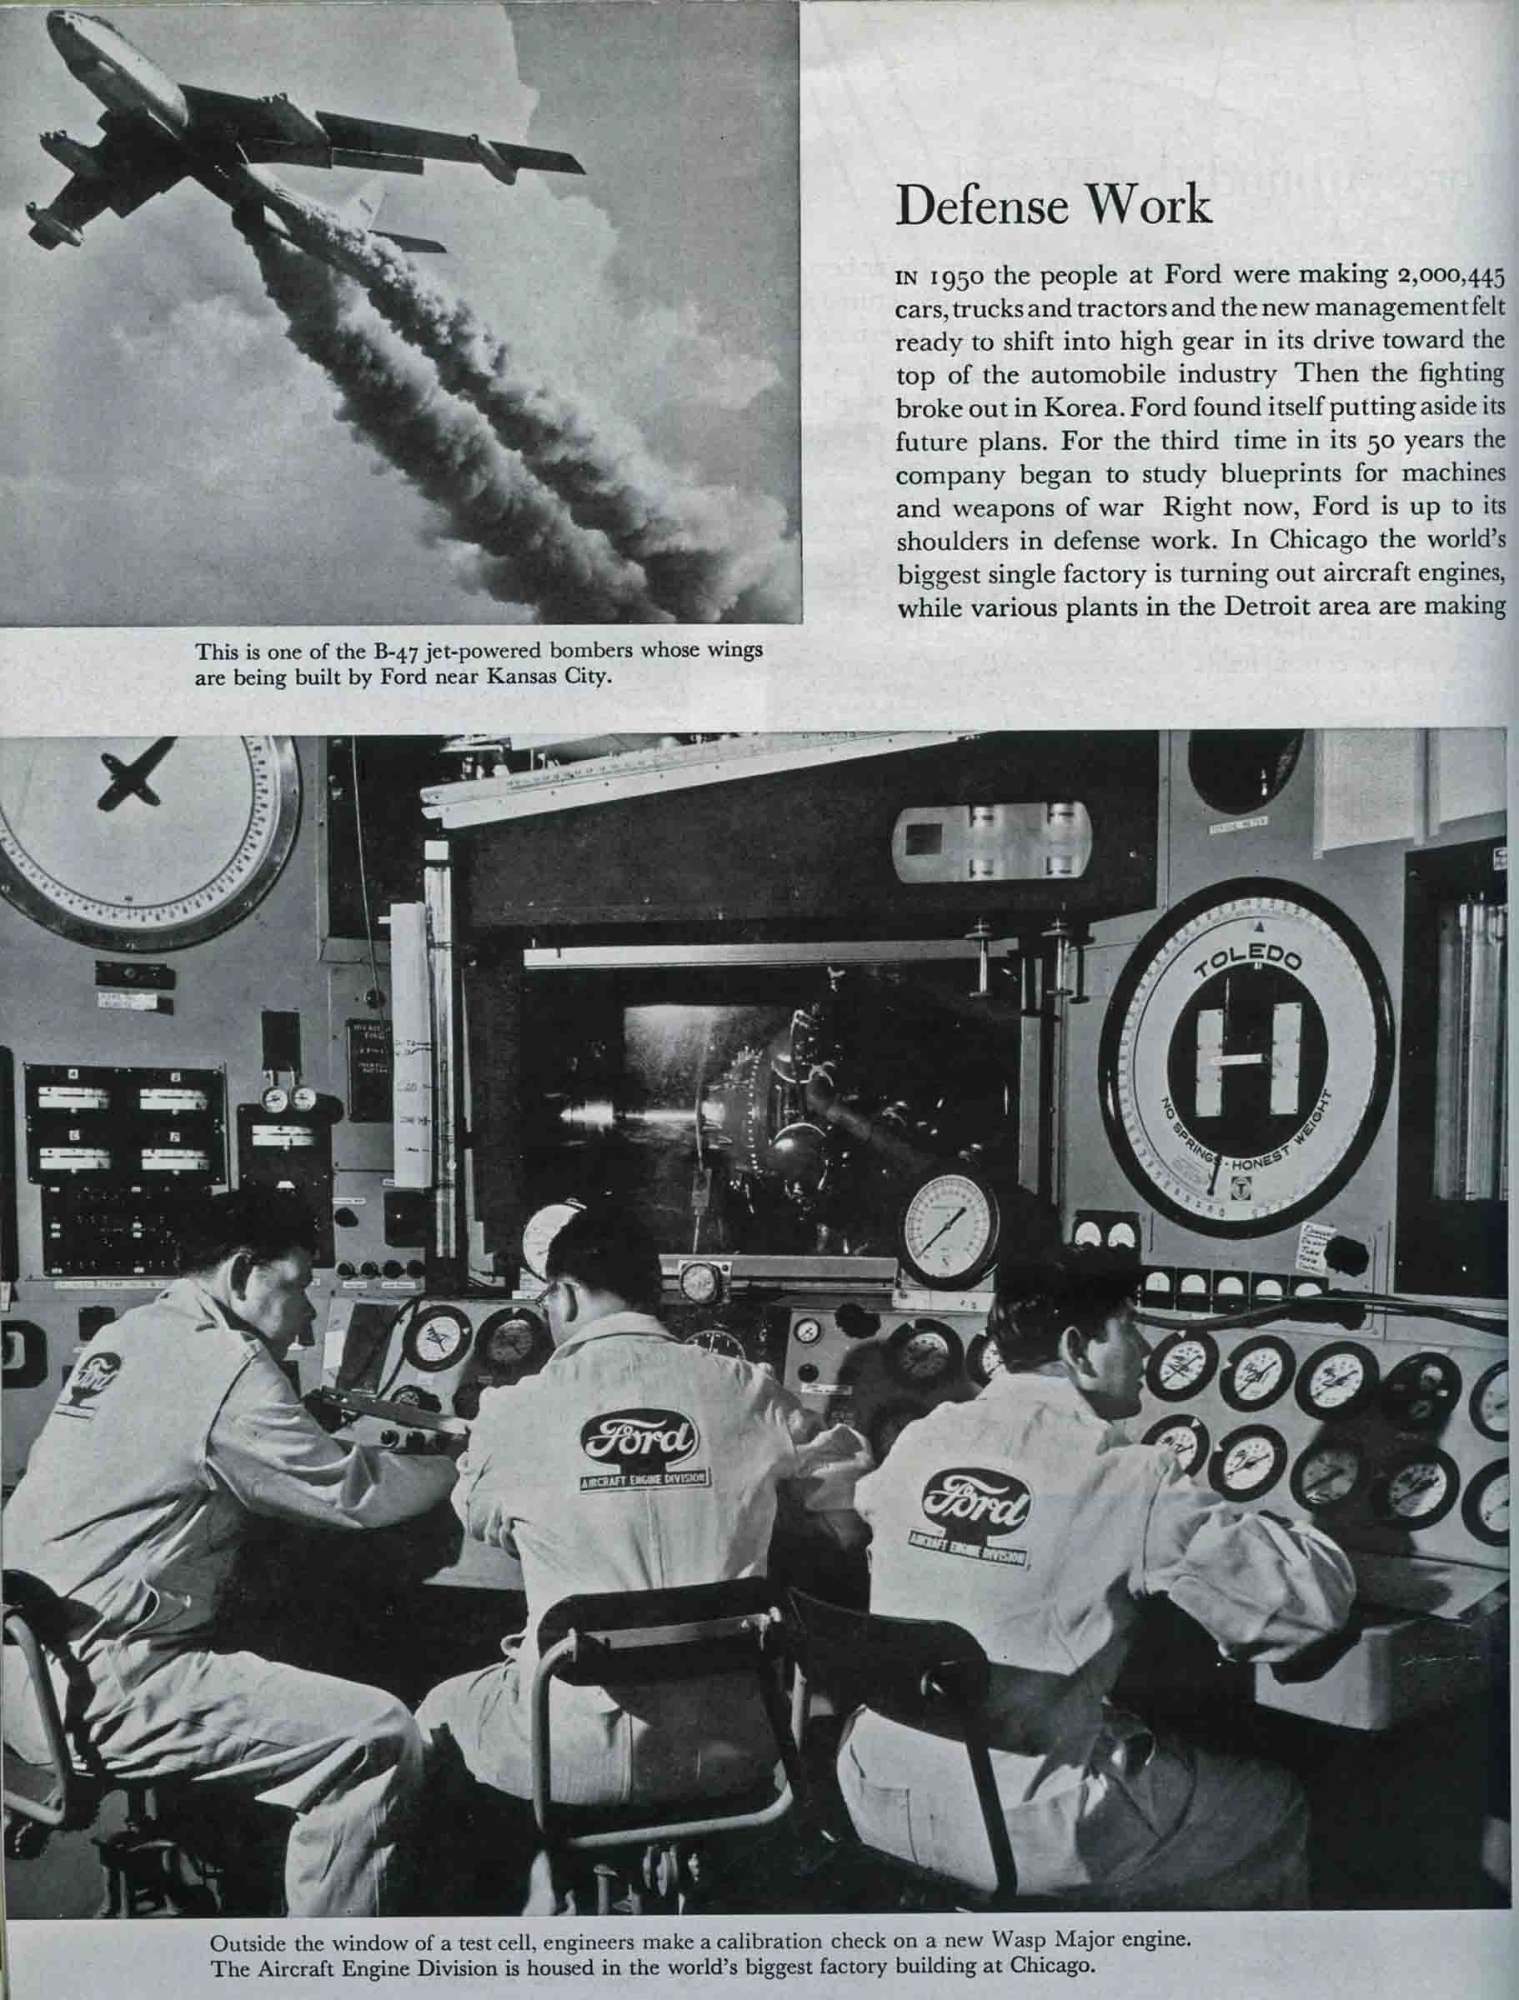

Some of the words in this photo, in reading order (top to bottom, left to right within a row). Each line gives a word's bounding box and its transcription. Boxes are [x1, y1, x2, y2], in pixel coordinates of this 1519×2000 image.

[895, 183, 1069, 225] Defense
[1083, 180, 1214, 225] Work
[893, 269, 919, 286] IN
[930, 269, 985, 293] 1950
[993, 263, 1032, 286] the
[1039, 263, 1119, 292] people
[1128, 266, 1154, 285] at
[1163, 261, 1223, 285] Ford
[1232, 268, 1291, 285] were
[1297, 261, 1390, 290] making
[1397, 266, 1506, 290] 2,000,445
[894, 303, 950, 324] cars,
[951, 297, 1025, 320] trucks
[1027, 296, 1073, 319] and
[1074, 299, 1169, 319] tractors
[1170, 295, 1217, 318] and
[1220, 295, 1259, 318] the
[1260, 301, 1311, 318] new
[1313, 298, 1470, 323] management
[1471, 294, 1507, 317] felt
[894, 330, 969, 358] ready
[970, 334, 995, 353] to
[1002, 329, 1055, 352] shift
[1063, 329, 1112, 352] into
[1119, 328, 1175, 357] high
[1182, 334, 1235, 357] gear
[1243, 328, 1269, 351] in
[1277, 327, 1305, 352] its
[1311, 328, 1375, 351] drive
[1381, 327, 1465, 350] toward
[1471, 327, 1506, 350] the
[896, 367, 936, 392] top
[947, 362, 974, 386] of
[982, 362, 1021, 385] the
[1030, 362, 1167, 385] automobile
[1177, 361, 1279, 390] industry
[1293, 360, 1361, 384] Then
[1368, 361, 1409, 385] the
[1417, 360, 1507, 389] fighting
[894, 396, 965, 420] broke
[968, 400, 1010, 420] out
[1013, 396, 1039, 419] in
[1042, 395, 1126, 420] Korea.
[1129, 395, 1188, 418] Ford
[1192, 395, 1265, 418] found
[1267, 394, 1327, 417] itself
[1328, 394, 1418, 424] putting
[1419, 393, 1478, 416] aside
[1482, 394, 1507, 416] its
[895, 429, 969, 453] future
[978, 429, 1048, 458] plans.
[1059, 429, 1104, 452] For
[1112, 429, 1152, 451] the
[1159, 428, 1221, 452] third
[1233, 428, 1288, 451] time
[1296, 427, 1321, 450] in
[1325, 427, 1358, 450] its
[1366, 433, 1396, 457] 50
[1403, 433, 1465, 456] years
[1473, 426, 1507, 450] the
[896, 527, 1010, 553] shoulders
[1019, 529, 1045, 551] in
[1053, 528, 1141, 553] defense
[1149, 529, 1219, 552] work.
[1230, 528, 1259, 550] In
[1269, 527, 1369, 556] Chicago
[1378, 525, 1417, 549] the
[1426, 526, 1507, 549] world's
[896, 563, 982, 591] biggest
[987, 562, 1057, 591] single
[1062, 561, 1148, 590] factory
[1153, 561, 1173, 584] is
[1179, 561, 1270, 590] turning
[1275, 564, 1317, 583] out
[1322, 560, 1412, 584] aircraft
[1417, 560, 1506, 588] engines,
[896, 595, 963, 620] while
[970, 595, 1059, 619] various
[1065, 595, 1139, 625] plants
[1144, 594, 1172, 617] in
[1177, 593, 1217, 617] the
[1223, 594, 1312, 617] Detroit
[1318, 600, 1372, 617] area
[1378, 598, 1417, 616] are
[1423, 593, 1508, 621] making
[194, 642, 240, 661] This
[245, 642, 261, 661] is
[267, 647, 303, 662] one
[308, 642, 331, 661] of
[334, 641, 367, 661] the
[372, 641, 419, 665] B-47
[422, 641, 542, 665] jet-powered
[549, 640, 634, 660] bombers
[640, 639, 701, 660] whose
[706, 639, 764, 664] wings
[194, 673, 227, 687] are
[233, 667, 288, 692] being
[294, 666, 342, 686] built
[347, 667, 374, 691] by
[379, 666, 428, 686] Ford
[434, 671, 480, 686] near
[485, 665, 558, 686] Kansas
[564, 665, 613, 689] City.
[1193, 943, 1304, 978] TOLEDO
[1160, 1097, 1175, 1119] NO
[1232, 1145, 1290, 1171] HONEST
[1293, 1088, 1333, 1145] WEIGHT
[585, 1418, 694, 1458] Ford
[581, 1475, 626, 1490] AIRCRAFT
[630, 1473, 662, 1485] ENGINE
[664, 1470, 706, 1485] DIVISION
[923, 1474, 1031, 1526] Ford
[209, 1934, 287, 1954] Outside
[293, 1934, 325, 1953] the
[331, 1933, 409, 1952] window
[414, 1933, 436, 1952] of
[440, 1939, 453, 1953] a
[457, 1936, 493, 1952] test
[497, 1932, 538, 1954] cell,
[543, 1933, 636, 1956] engineers
[641, 1932, 695, 1951] make
[699, 1937, 712, 1951] a
[716, 1931, 823, 1952] calibration
[830, 1931, 888, 1950] check
[893, 1936, 919, 1949] on
[925, 1935, 938, 1949] a
[944, 1934, 985, 1949] new
[991, 1929, 1047, 1954] Wasp
[1054, 1929, 1116, 1953] Major
[1121, 1929, 1192, 1953] engine.
[209, 1959, 251, 1979] The
[256, 1958, 335, 1978] Aircraft
[341, 1959, 411, 1983] Engine
[416, 1957, 499, 1978] Division
[504, 1959, 521, 1977] is
[526, 1957, 596, 1977] housed
[601, 1958, 623, 1978] in
[628, 1957, 661, 1977] the
[667, 1956, 739, 1976] world's
[744, 1956, 814, 1982] biggest
[819, 1956, 889, 1980] factory
[895, 1955, 978, 1981] building
[982, 1959, 1004, 1974] at
[1009, 1954, 1097, 1979] Chicago.
